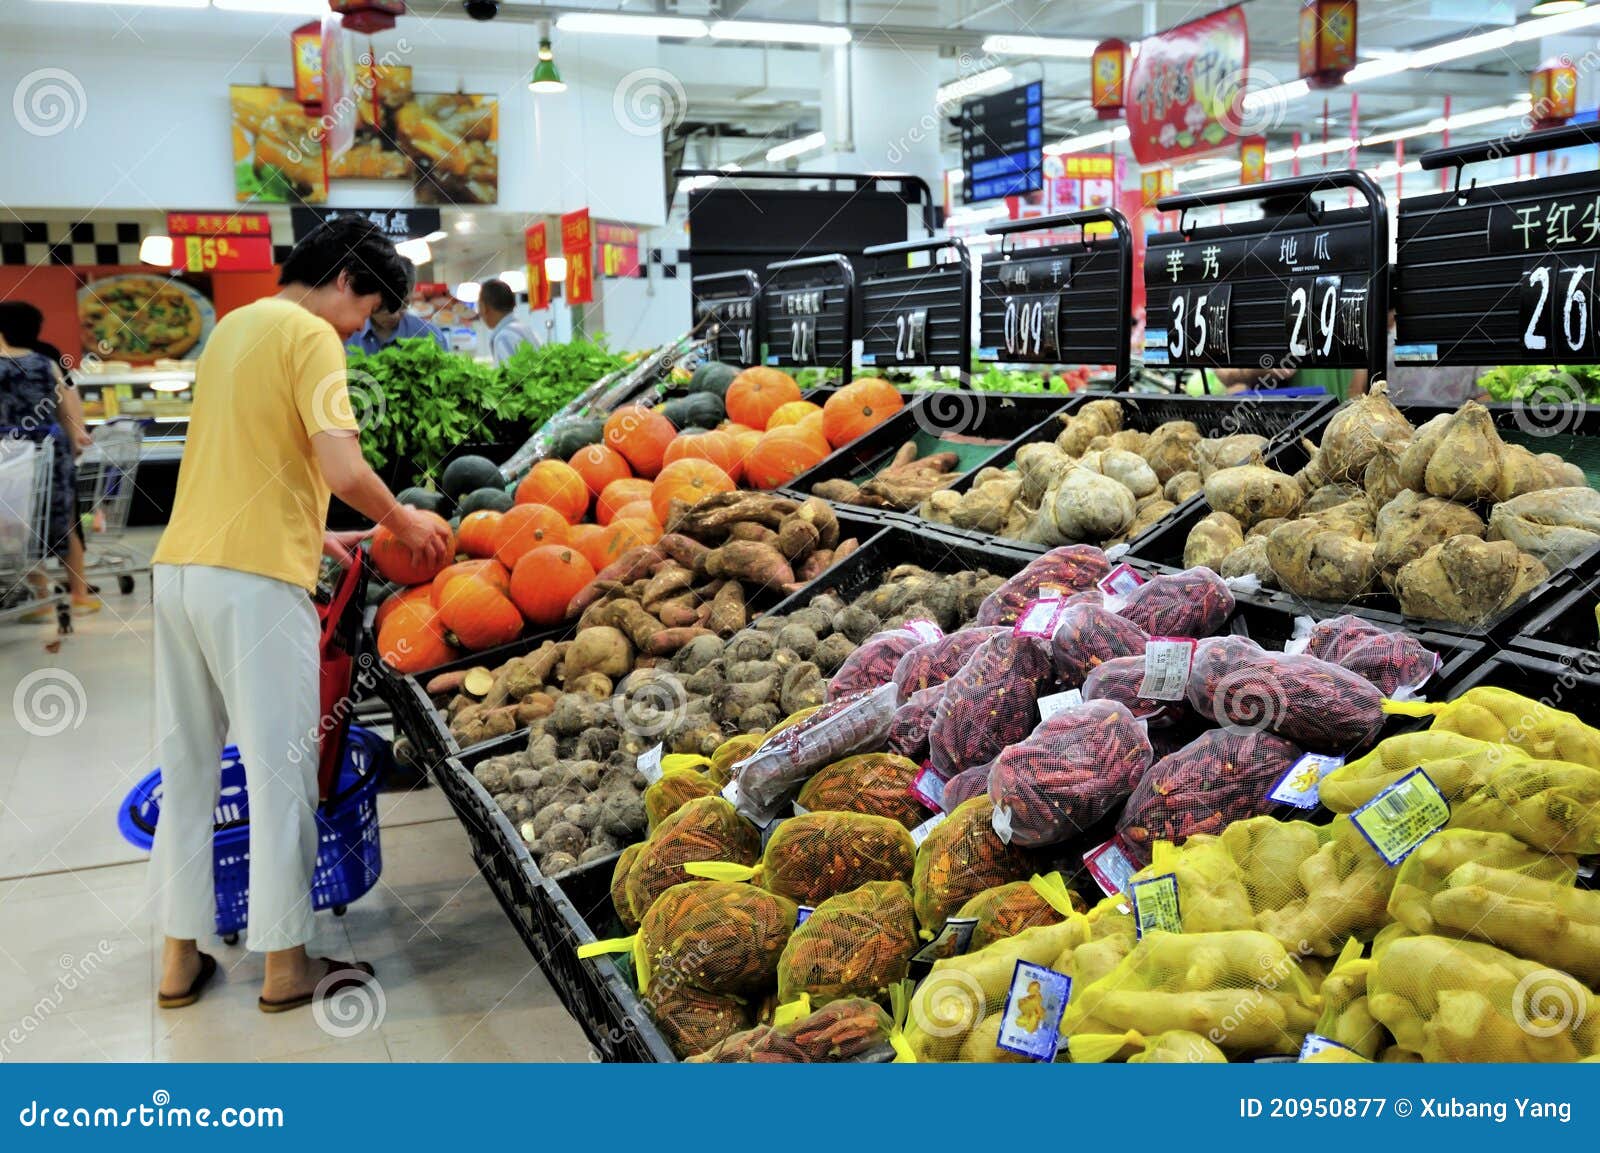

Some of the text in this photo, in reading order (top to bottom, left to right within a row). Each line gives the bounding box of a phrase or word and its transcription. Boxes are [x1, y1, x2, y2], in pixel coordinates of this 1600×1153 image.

[1279, 232, 1331, 264] 地瓜
[1170, 295, 1208, 358] 3.5
[1290, 286, 1337, 357] 2.9
